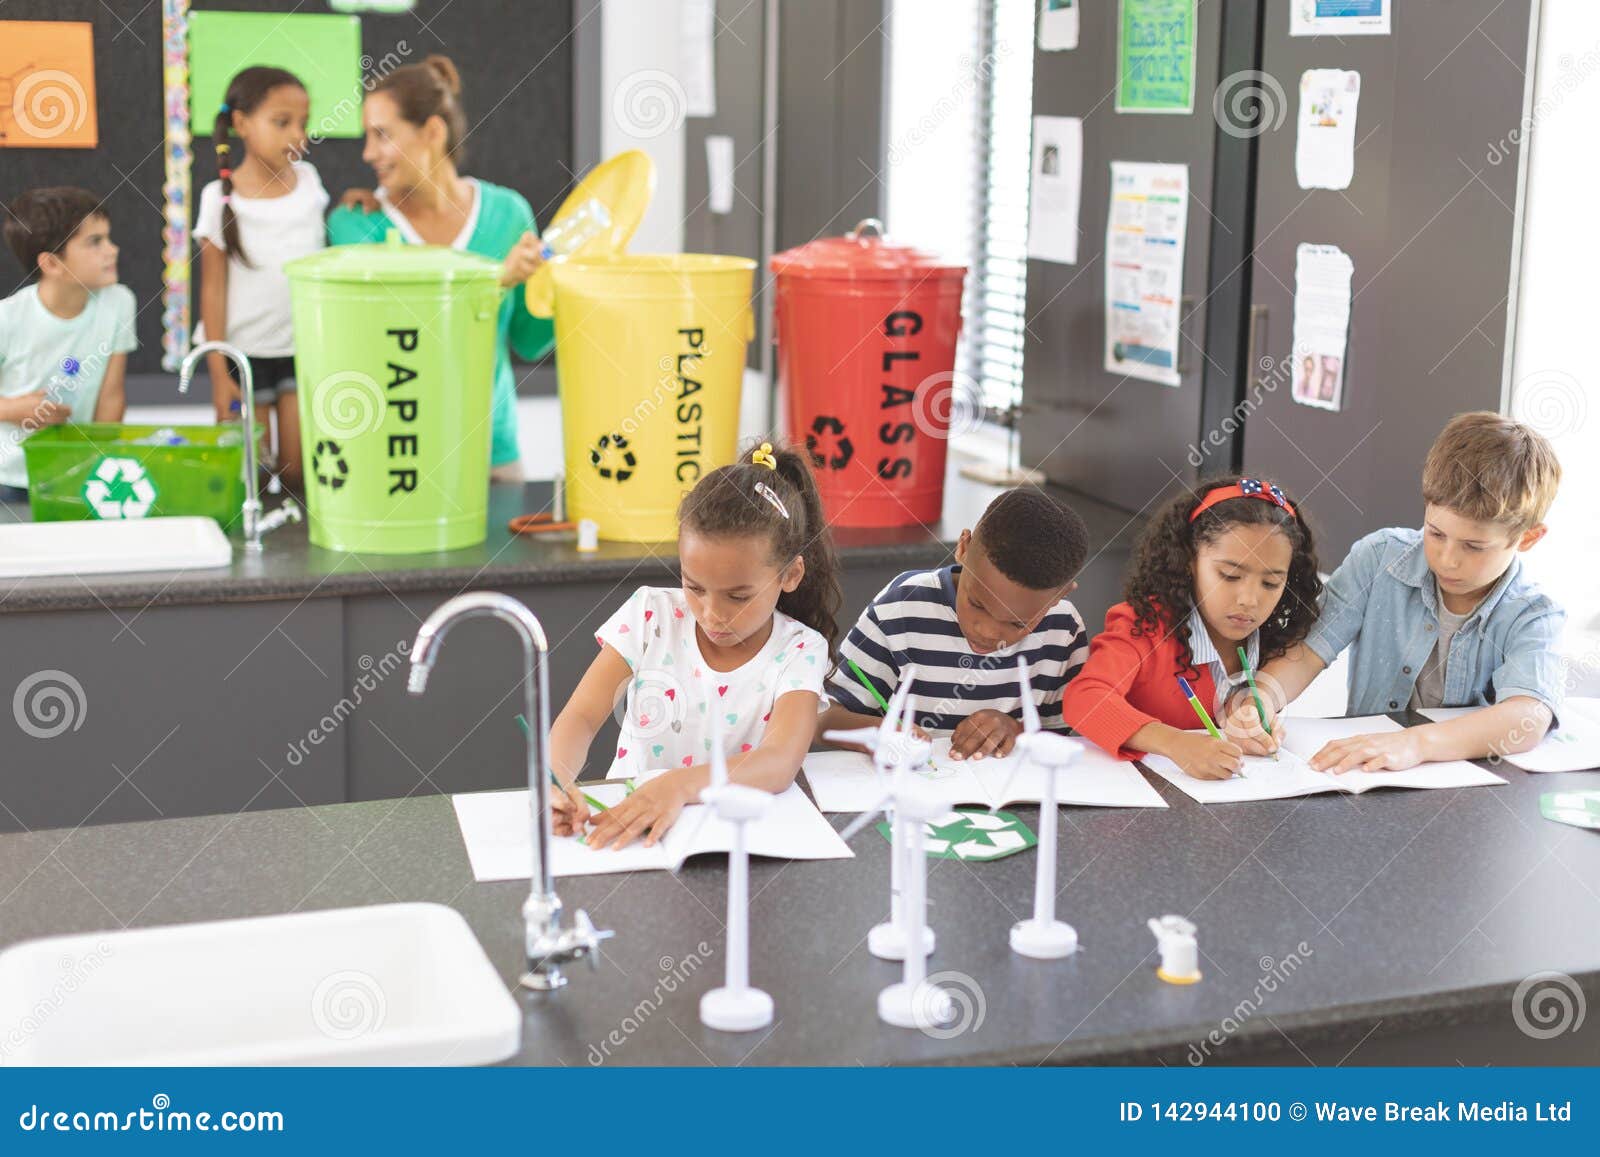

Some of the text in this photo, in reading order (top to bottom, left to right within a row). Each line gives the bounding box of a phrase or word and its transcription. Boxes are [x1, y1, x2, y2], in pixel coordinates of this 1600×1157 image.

[387, 329, 418, 495] PAPER
[677, 328, 704, 482] PLASTIC
[879, 311, 923, 480] GLASS
